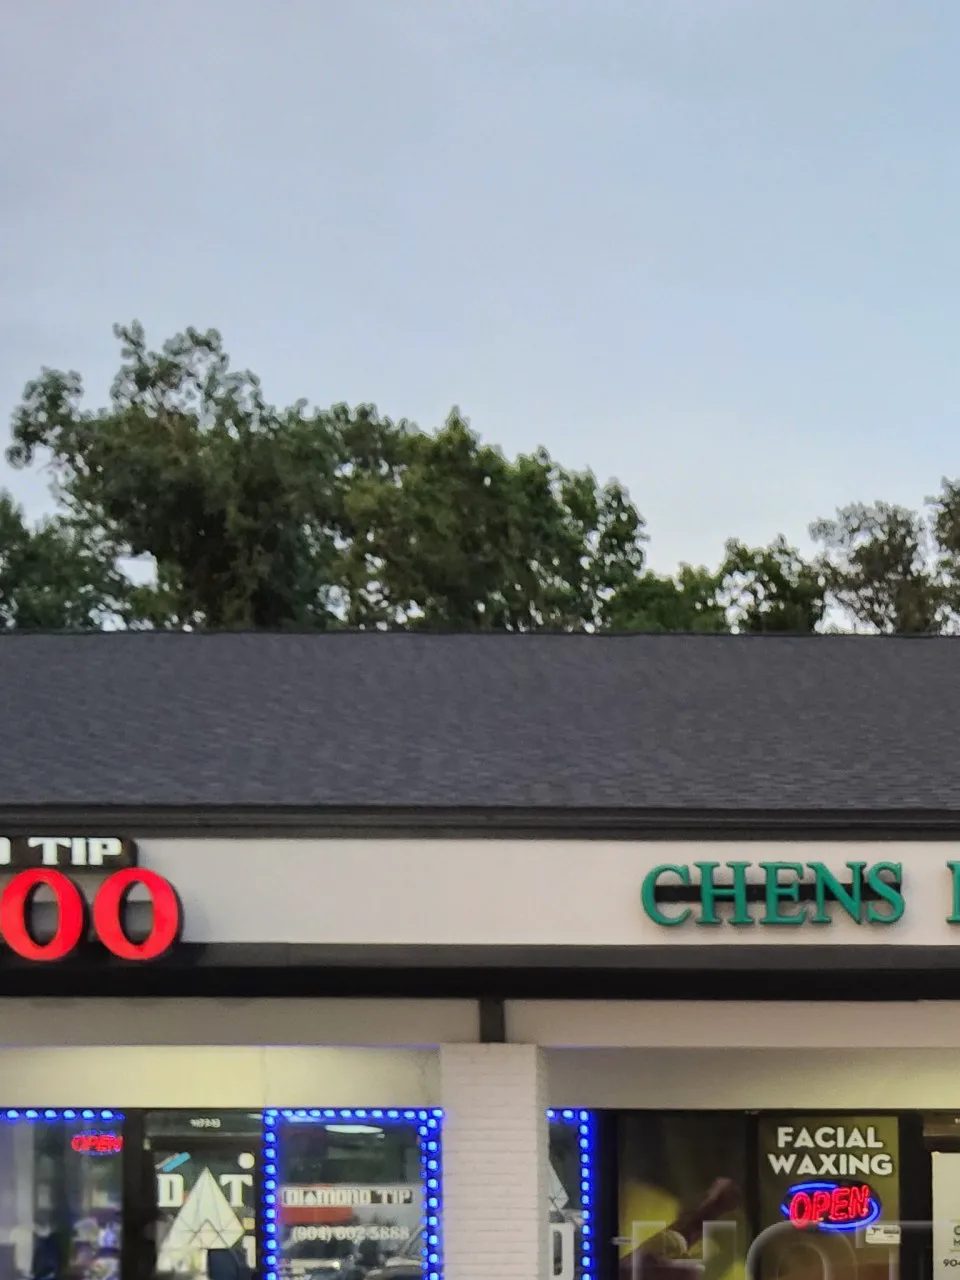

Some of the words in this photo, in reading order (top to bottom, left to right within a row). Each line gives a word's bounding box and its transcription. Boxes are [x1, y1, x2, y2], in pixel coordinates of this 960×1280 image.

[28, 836, 123, 866] TIP
[641, 860, 906, 926] CHENS
[776, 1126, 884, 1148] FACIAL
[767, 1153, 893, 1175] WAXING
[789, 1184, 871, 1229] OPEN
